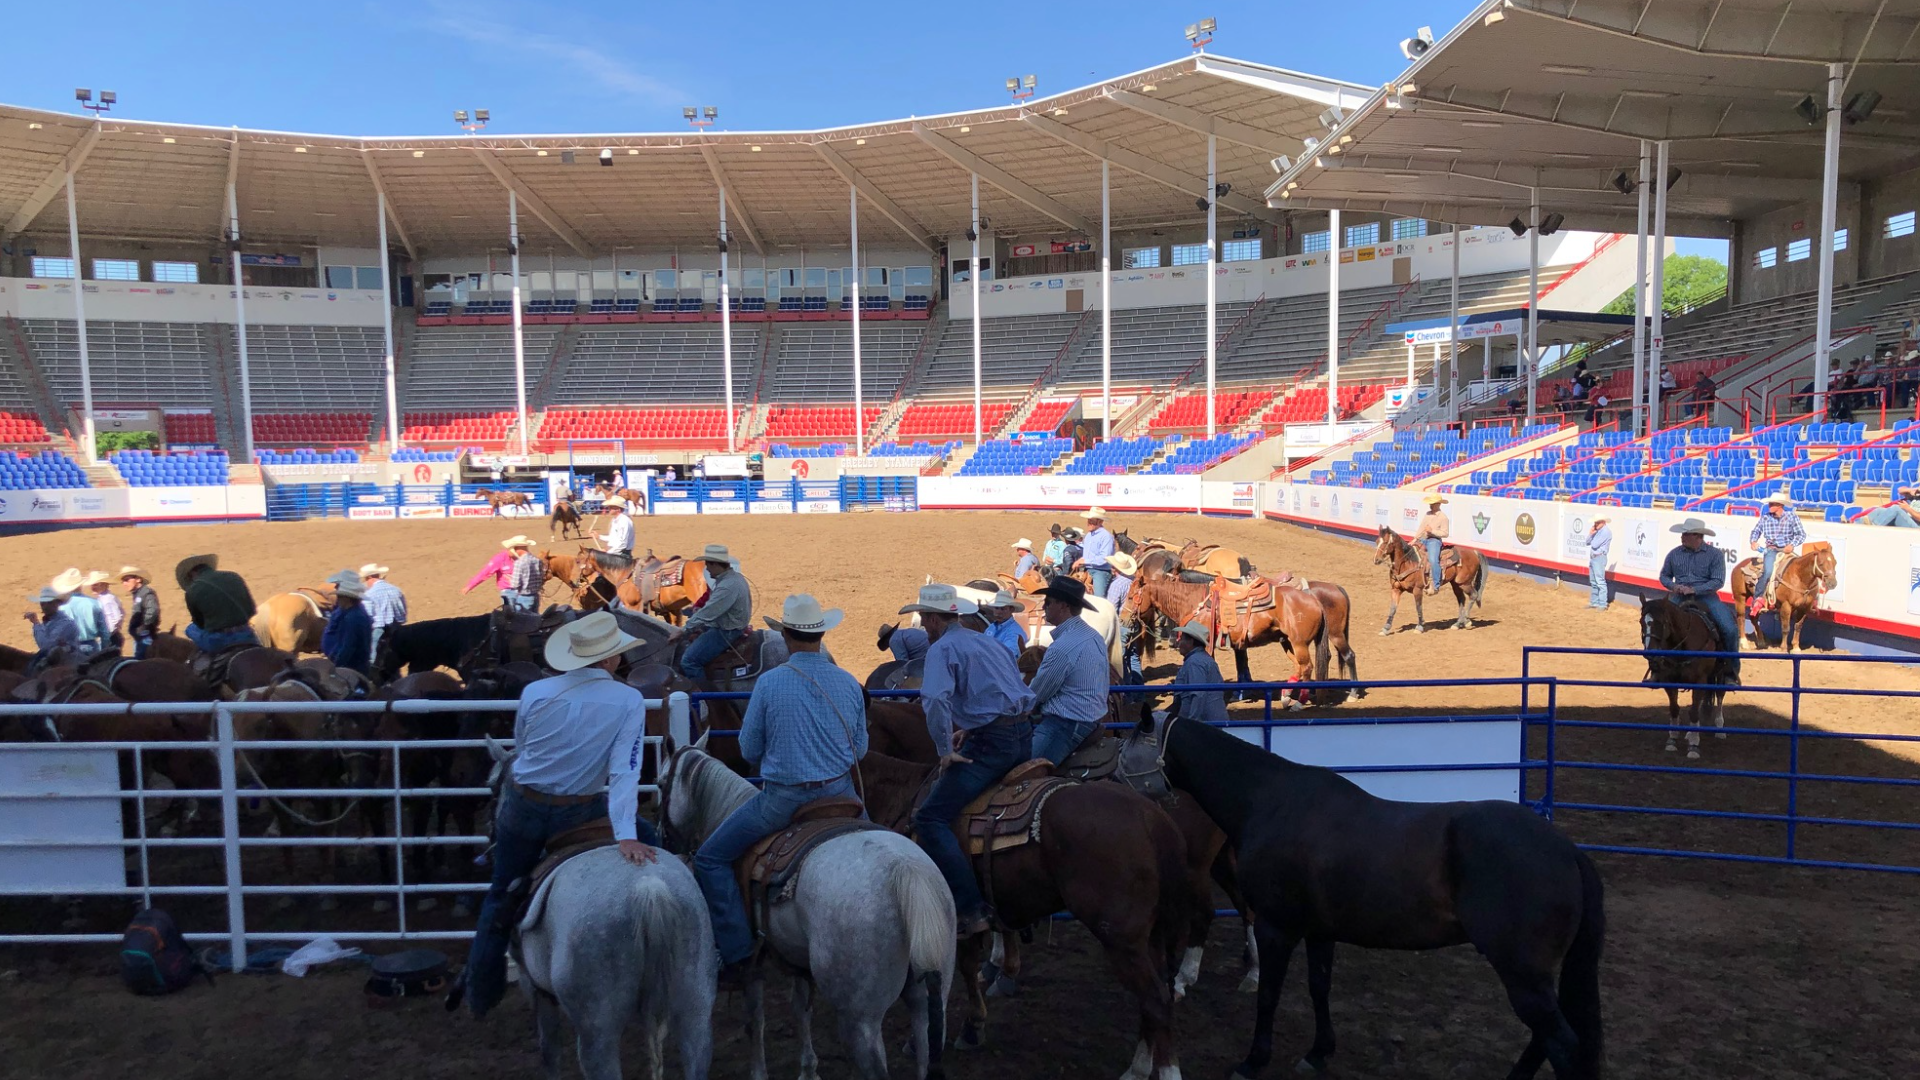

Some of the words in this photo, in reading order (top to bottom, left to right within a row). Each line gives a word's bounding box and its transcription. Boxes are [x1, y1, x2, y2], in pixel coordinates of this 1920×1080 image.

[1417, 331, 1445, 341] Chevron
[1654, 338, 1664, 348] T
[1531, 363, 1537, 372] S
[574, 454, 616, 464] MONFORT
[625, 454, 659, 464] CHUTES
[841, 457, 879, 468] GREELEY
[270, 464, 317, 475] GREELEY
[322, 464, 379, 475] STAMPEDE
[452, 507, 494, 516] BURNCO
[1516, 525, 1534, 536] MURDOCK'S
[1627, 548, 1640, 556] Animal
[1641, 549, 1653, 558] Health
